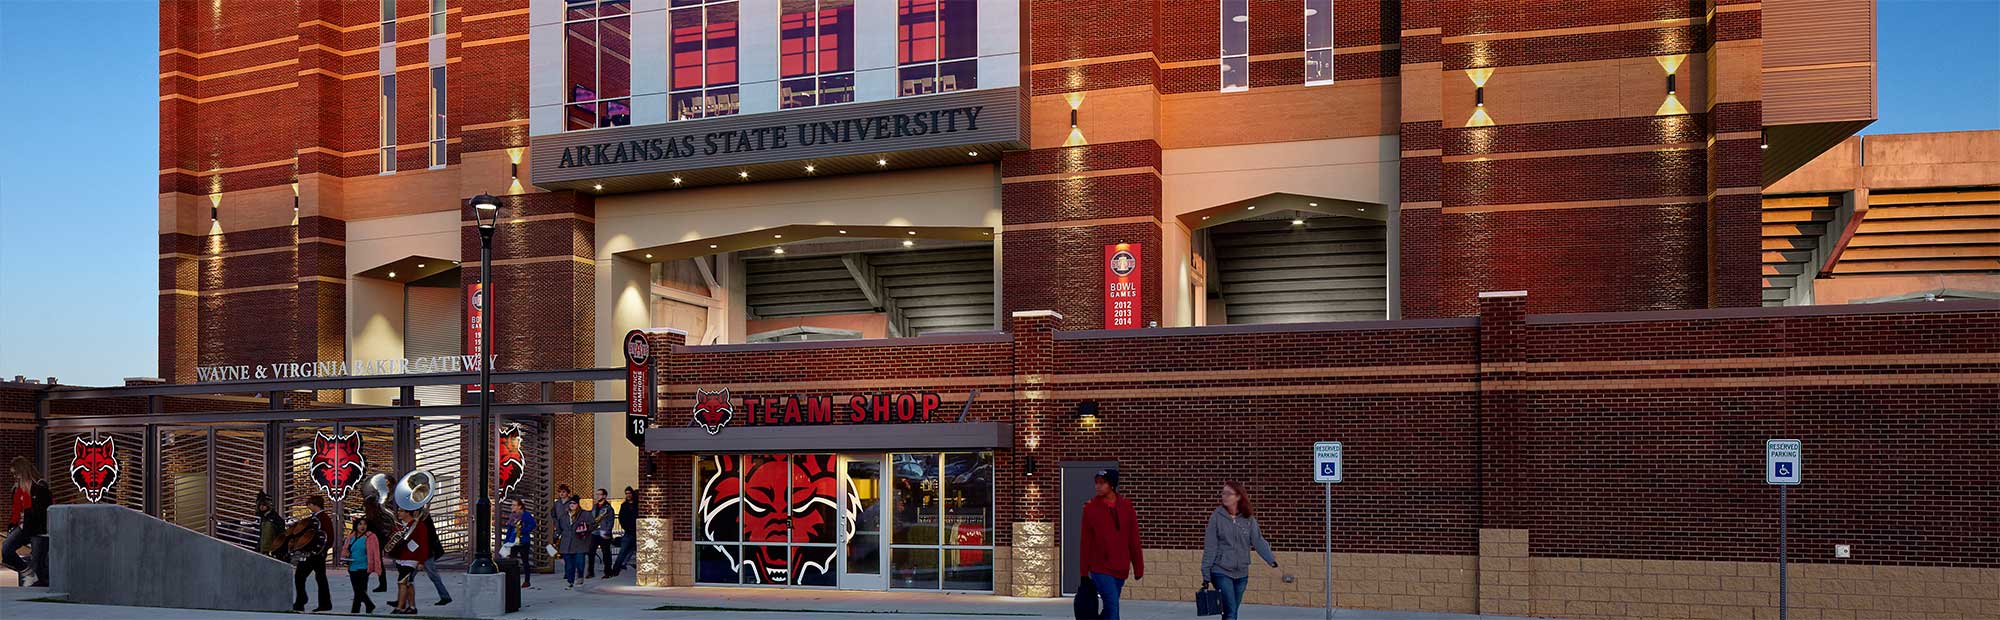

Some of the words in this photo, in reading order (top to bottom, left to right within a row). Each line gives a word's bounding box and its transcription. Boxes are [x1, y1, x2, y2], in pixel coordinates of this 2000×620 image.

[558, 134, 696, 169] ARKANSAS
[703, 125, 788, 156] STATE
[798, 106, 984, 146] UNIVERSITY
[1110, 282, 1136, 291] BOWL
[1114, 301, 1132, 309] 2012
[1114, 309, 1132, 317] 2013
[1114, 317, 1132, 325] 2014
[197, 365, 250, 381] WAYNE
[255, 364, 268, 379] &
[271, 361, 349, 379] VIRGINIA
[354, 358, 409, 375] BAKER
[415, 354, 498, 373] GATEWY
[743, 396, 833, 424] TEAM
[850, 393, 942, 423] SHOP
[633, 419, 645, 434] 13
